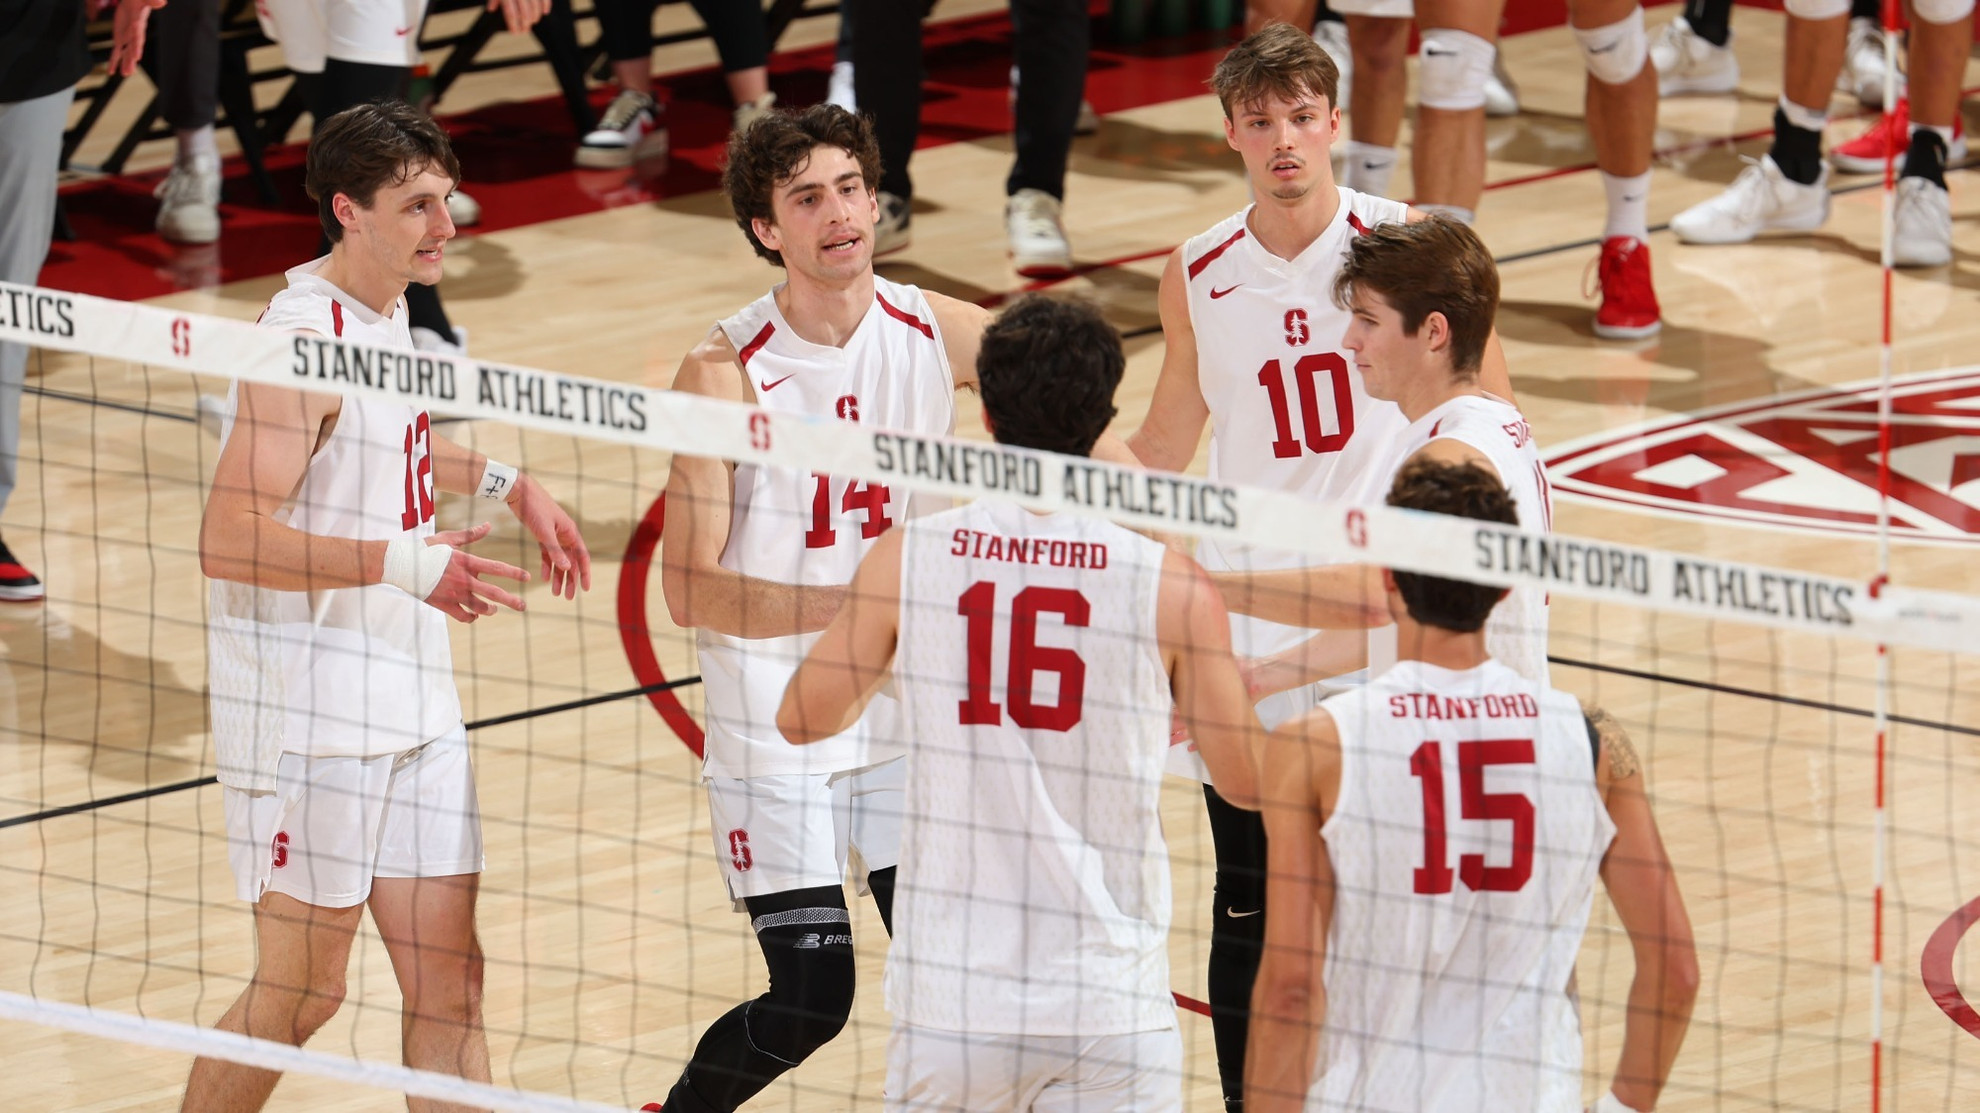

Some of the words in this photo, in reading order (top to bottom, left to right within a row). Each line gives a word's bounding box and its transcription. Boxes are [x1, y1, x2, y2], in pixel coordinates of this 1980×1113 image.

[292, 335, 457, 401] STANFORD
[476, 366, 648, 432] ATHLETICS
[1257, 351, 1355, 459] 10
[401, 409, 435, 532] 12
[806, 469, 893, 549] 14
[872, 432, 1042, 498] STANFORD
[1062, 463, 1239, 530] ATHLETICS
[950, 528, 1109, 570] STANFORD
[1473, 528, 1651, 596] STANFORD
[1672, 560, 1855, 627] ATHLETICS
[957, 579, 1091, 733] 16
[1389, 692, 1539, 720] STANFORD
[1409, 738, 1536, 895] 15
